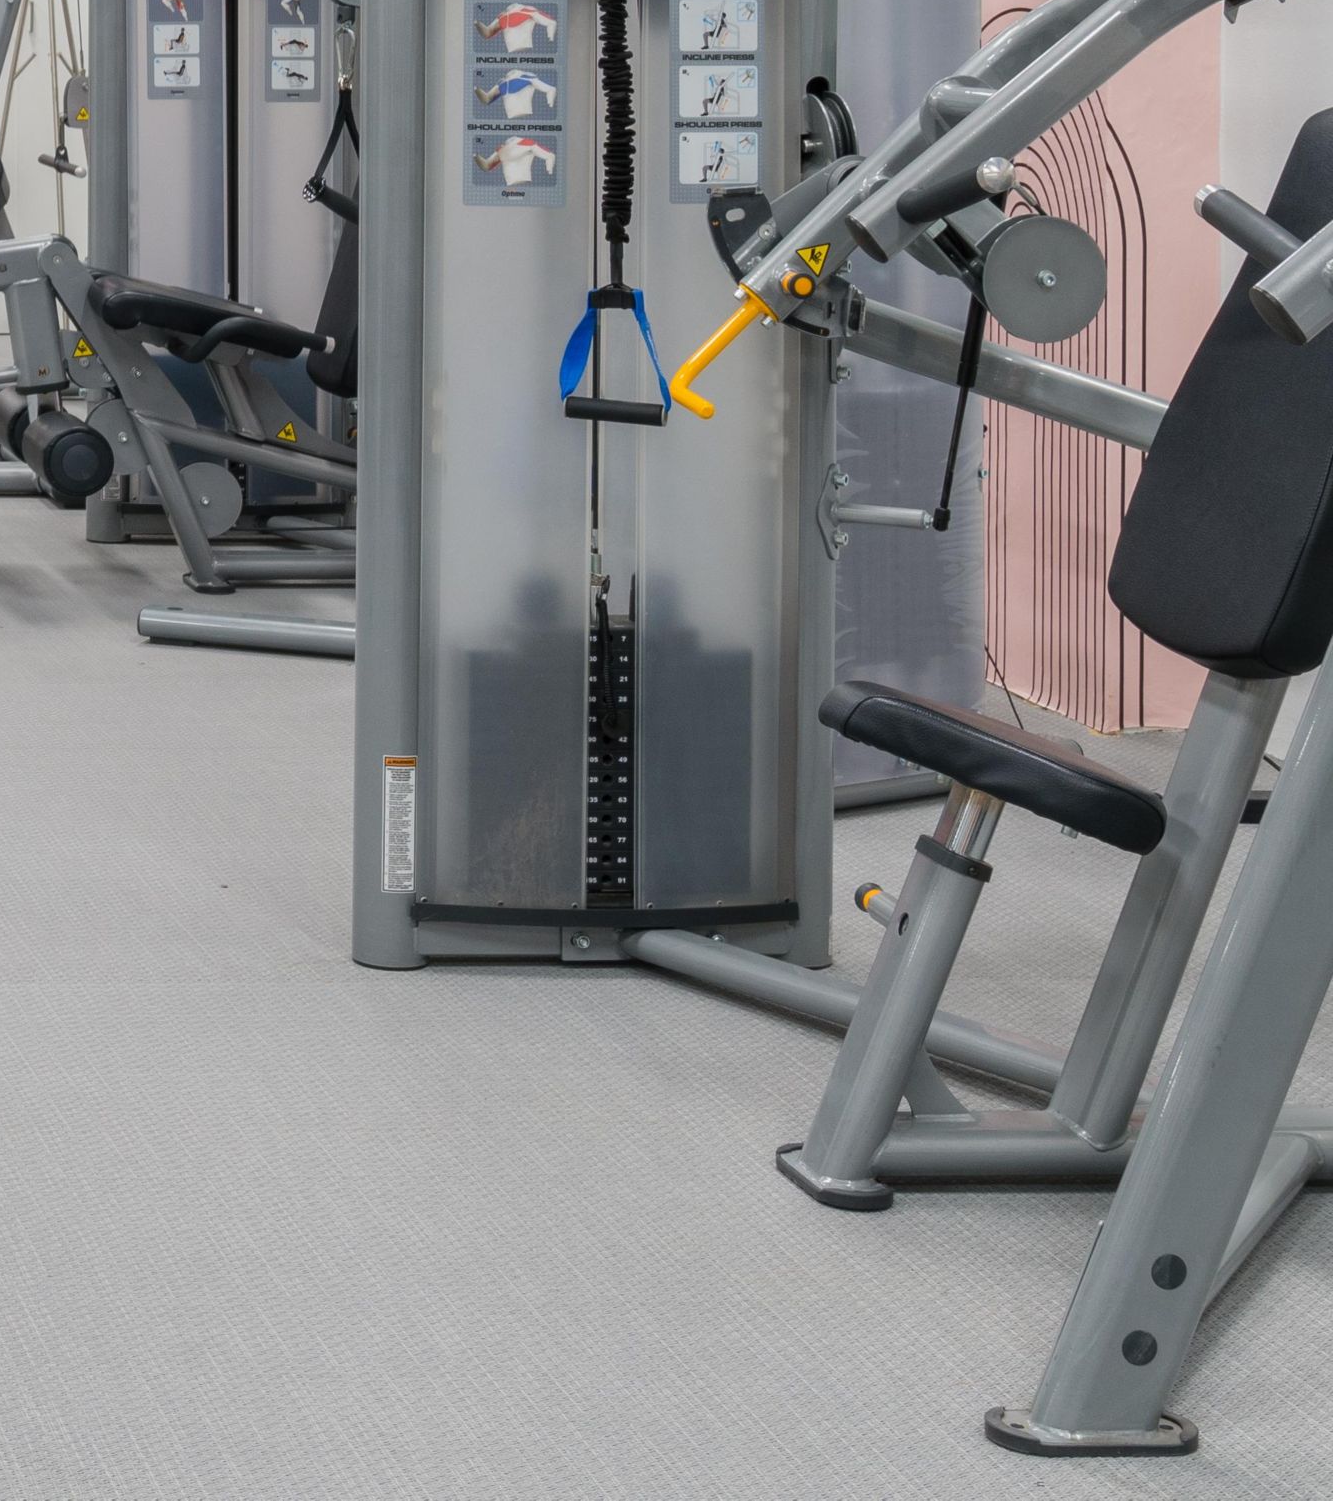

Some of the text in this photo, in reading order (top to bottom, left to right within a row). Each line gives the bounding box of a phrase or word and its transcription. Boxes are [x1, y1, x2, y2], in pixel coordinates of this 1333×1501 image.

[476, 56, 555, 65] INCLINE PRESS
[682, 53, 755, 61] INCLINE PRESS
[467, 123, 563, 132] SHOULDER PRESS
[674, 121, 729, 129] SHOULDER
